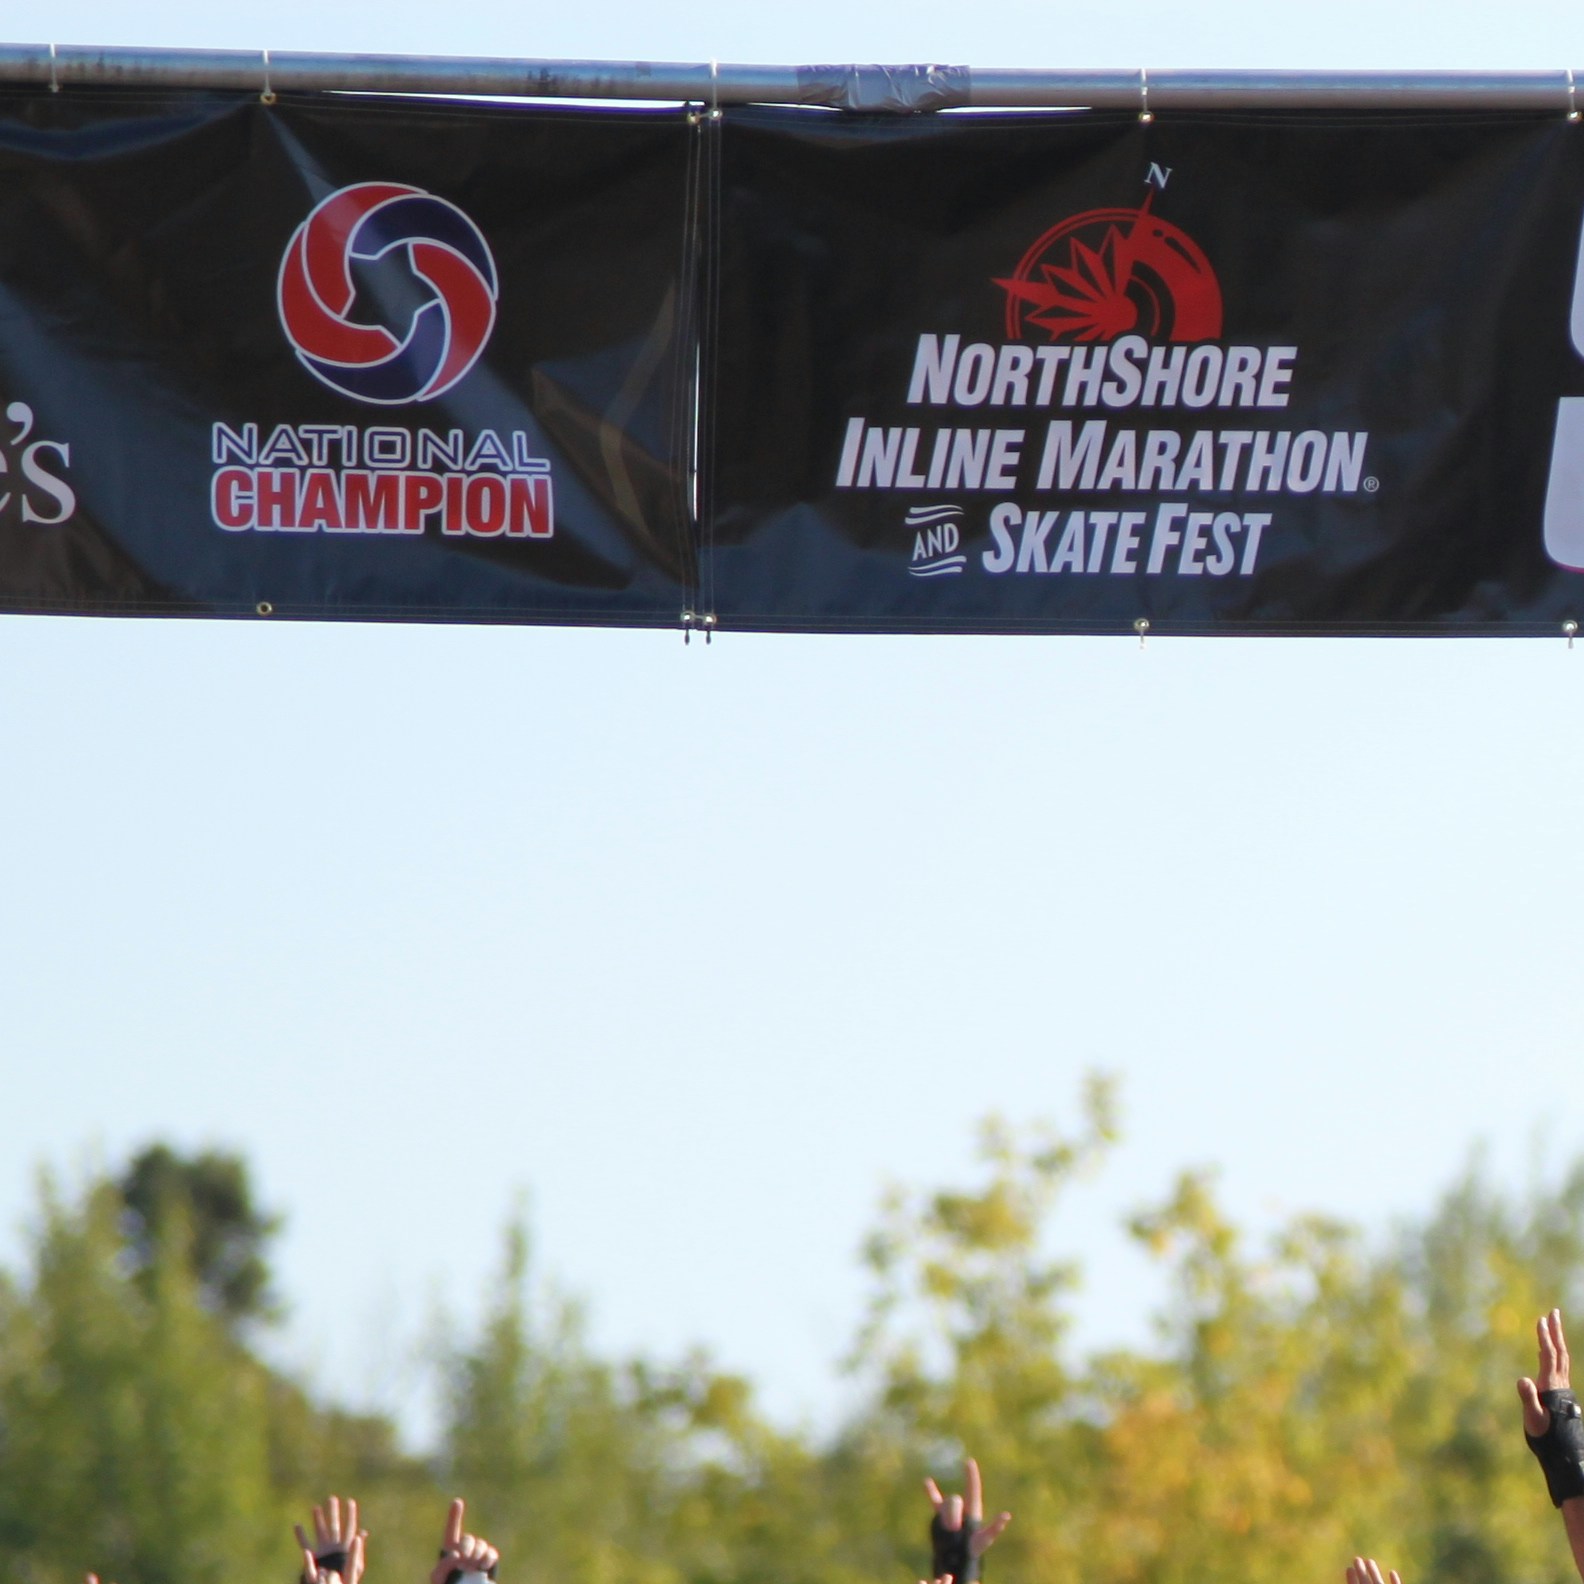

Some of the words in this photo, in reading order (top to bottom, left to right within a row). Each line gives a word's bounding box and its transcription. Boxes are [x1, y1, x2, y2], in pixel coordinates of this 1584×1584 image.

[1144, 162, 1173, 189] N
[906, 333, 1298, 407] NORTHSHORE
[212, 422, 551, 472] NATIONAL
[835, 417, 1025, 490] INLINE
[211, 466, 554, 538] CHAMPION
[912, 523, 960, 562] AND
